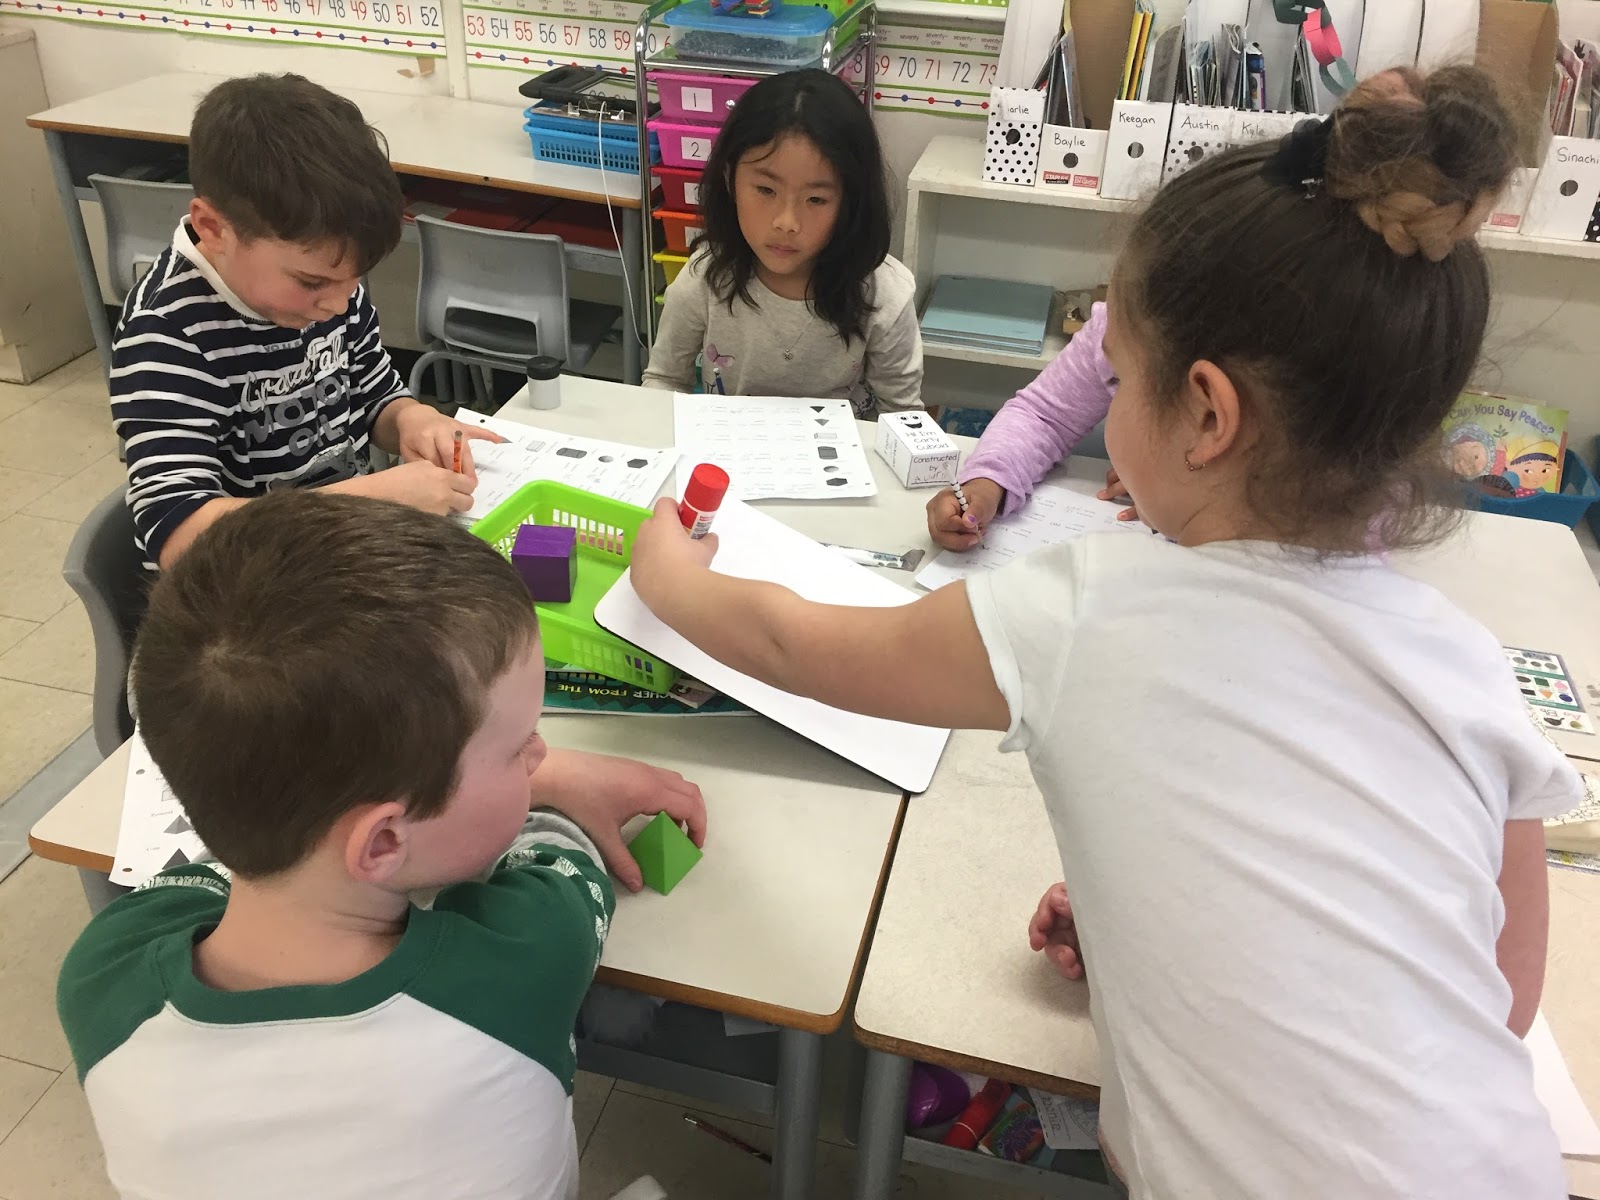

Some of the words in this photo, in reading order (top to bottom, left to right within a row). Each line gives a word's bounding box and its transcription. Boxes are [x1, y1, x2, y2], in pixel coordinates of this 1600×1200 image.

[284, 0, 301, 14] 46
[306, 0, 321, 15] 47
[328, 0, 346, 18] 48
[350, 0, 367, 20] 49
[372, 2, 391, 23] 50
[396, 4, 412, 25] 51
[420, 6, 439, 27] 52
[467, 15, 485, 36] 53
[490, 18, 509, 39] 54
[514, 20, 533, 41] 55
[538, 23, 557, 44] 56
[563, 25, 581, 46] 57
[589, 27, 606, 48] 58
[613, 30, 631, 51] 59
[898, 56, 917, 78] 70
[925, 58, 941, 80] 71
[952, 61, 971, 83] 72
[979, 63, 997, 85] 73
[1118, 111, 1156, 128] Keegan
[1181, 116, 1219, 131] Austin
[1241, 121, 1265, 138] Kyle
[1054, 133, 1086, 148] Baylie
[690, 141, 701, 158] 2
[1474, 403, 1495, 416] You
[1497, 404, 1518, 422] Say
[1518, 409, 1556, 436] Peace?
[913, 454, 958, 464] Constructed
[557, 683, 583, 693] THE
[588, 687, 628, 697] FROM
